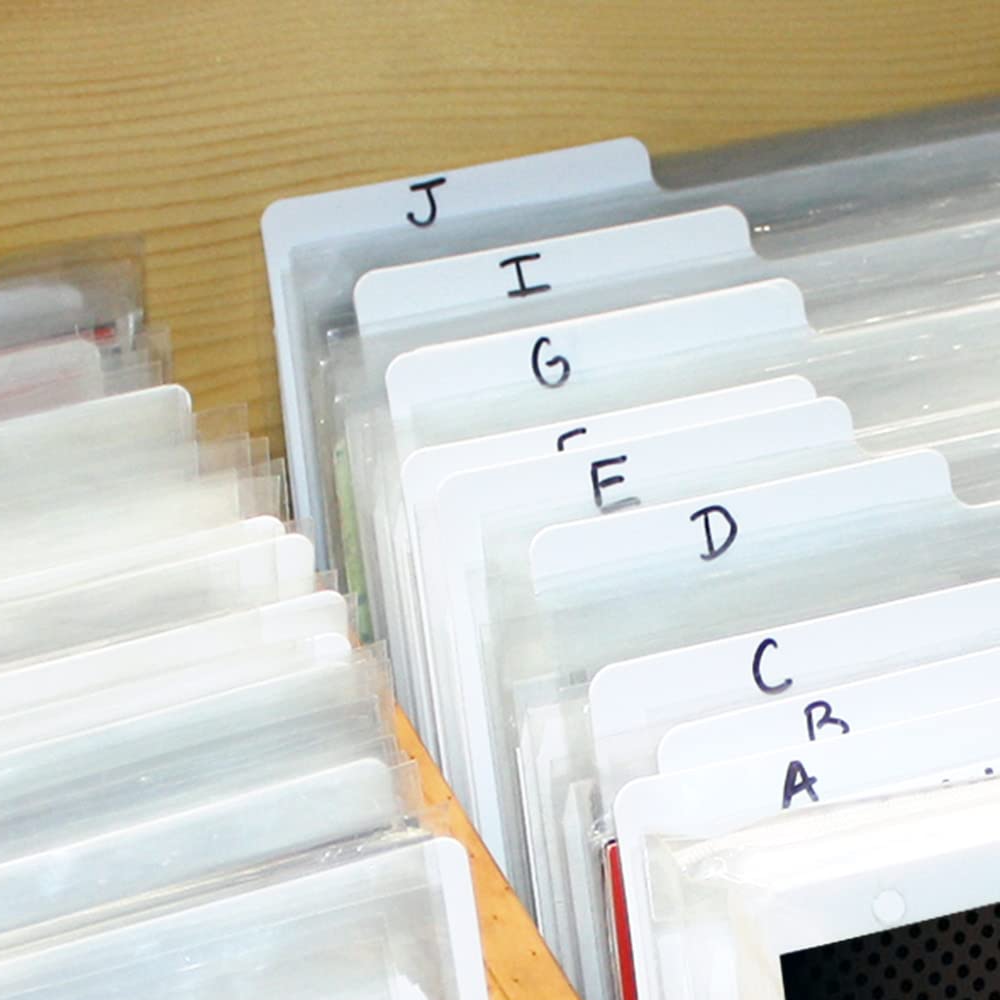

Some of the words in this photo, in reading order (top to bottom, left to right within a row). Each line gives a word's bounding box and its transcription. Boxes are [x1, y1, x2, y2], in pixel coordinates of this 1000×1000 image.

[405, 176, 447, 228] J
[499, 252, 552, 297] I
[530, 336, 572, 389] G
[590, 454, 642, 515] E
[690, 504, 740, 561] D
[752, 637, 794, 695] C
[781, 759, 820, 809] A
